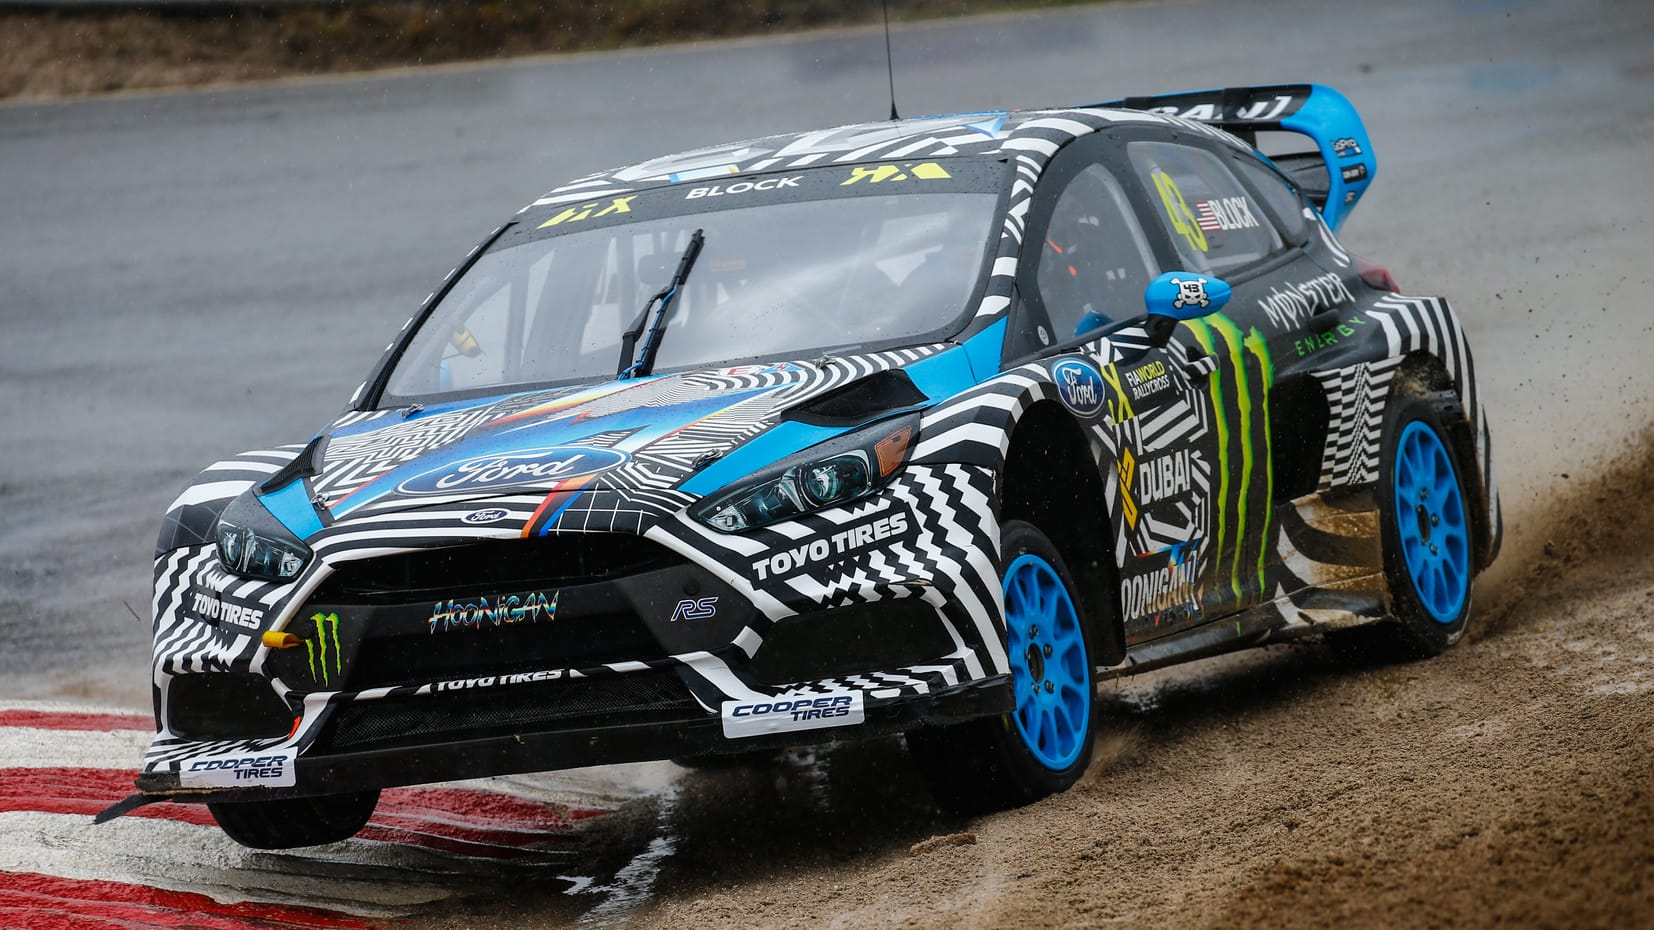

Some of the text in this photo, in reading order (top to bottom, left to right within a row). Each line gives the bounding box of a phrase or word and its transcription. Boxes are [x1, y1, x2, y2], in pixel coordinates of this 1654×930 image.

[685, 176, 804, 200] BLOCK
[1151, 170, 1208, 252] 43
[1208, 197, 1259, 230] BLOCK
[1183, 284, 1200, 293] 43
[1062, 366, 1098, 405] Ford
[436, 451, 585, 489] Ford
[1138, 448, 1191, 505] DUBAI
[471, 508, 503, 521] Ford
[752, 512, 909, 581] TOYO TIRES
[191, 593, 264, 630] TOYO TIRES
[670, 596, 719, 622] RS
[438, 668, 566, 692] TOYO TIRES
[731, 695, 853, 718] COOPER
[791, 706, 851, 722] TIRES
[190, 755, 288, 771] COOPER
[233, 767, 283, 780] TIRES
